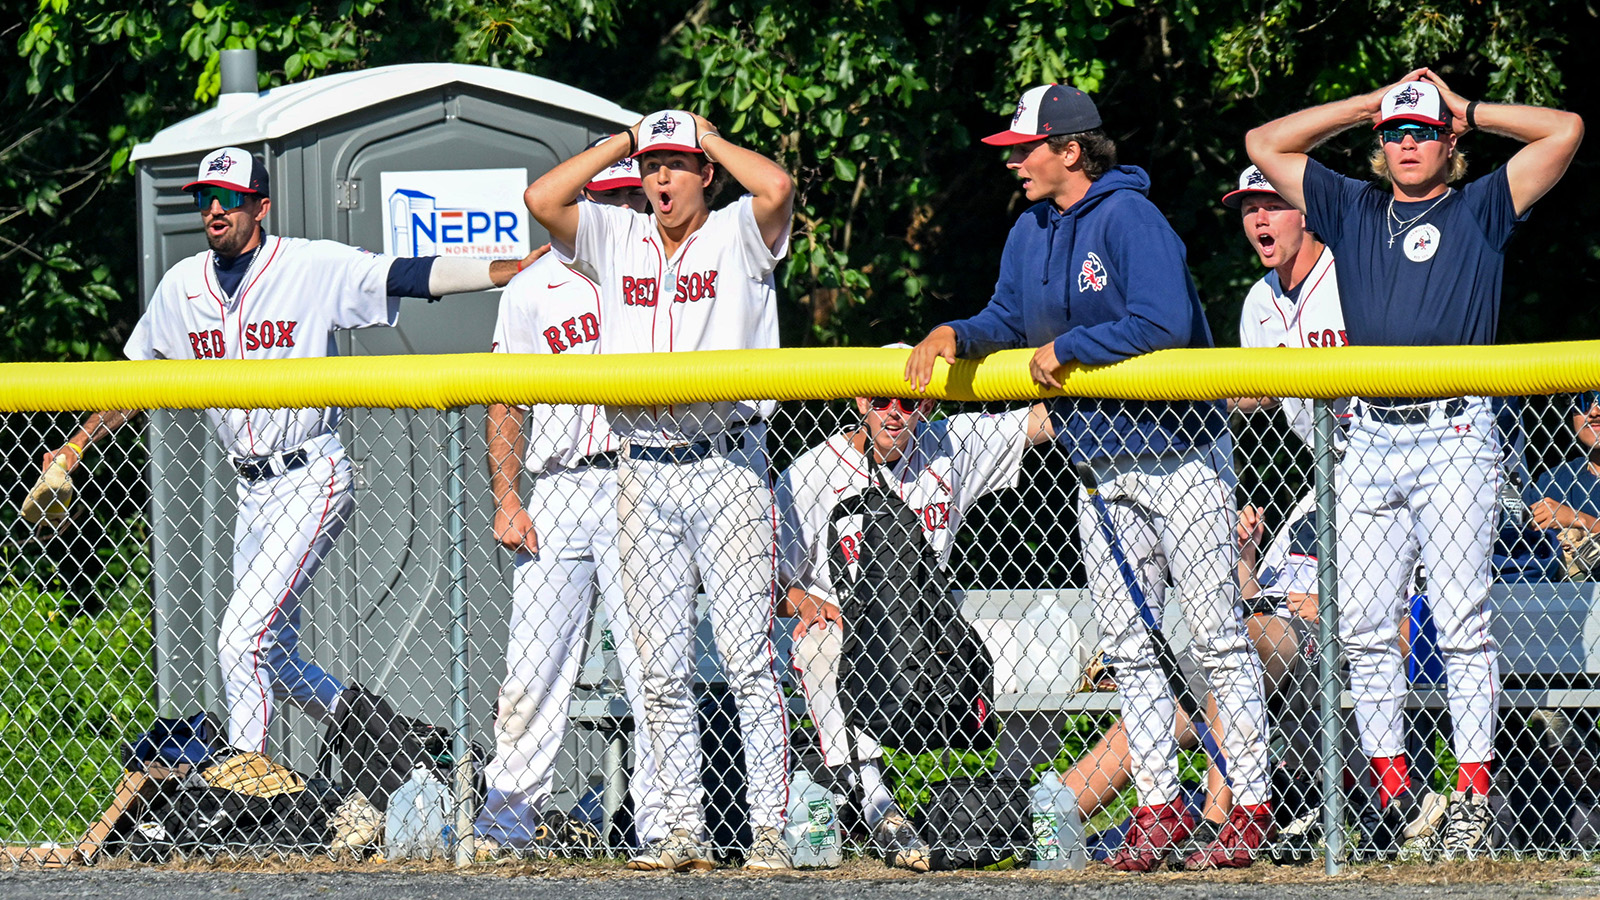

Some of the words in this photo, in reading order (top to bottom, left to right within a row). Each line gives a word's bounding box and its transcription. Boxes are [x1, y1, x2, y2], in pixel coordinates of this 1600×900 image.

[412, 211, 519, 257] NEPR
[445, 245, 514, 255] NORTHEAST
[622, 276, 656, 307] RED
[674, 270, 718, 303] SOX
[188, 329, 225, 359] RED
[245, 320, 297, 351] SOX
[543, 312, 600, 354] RED
